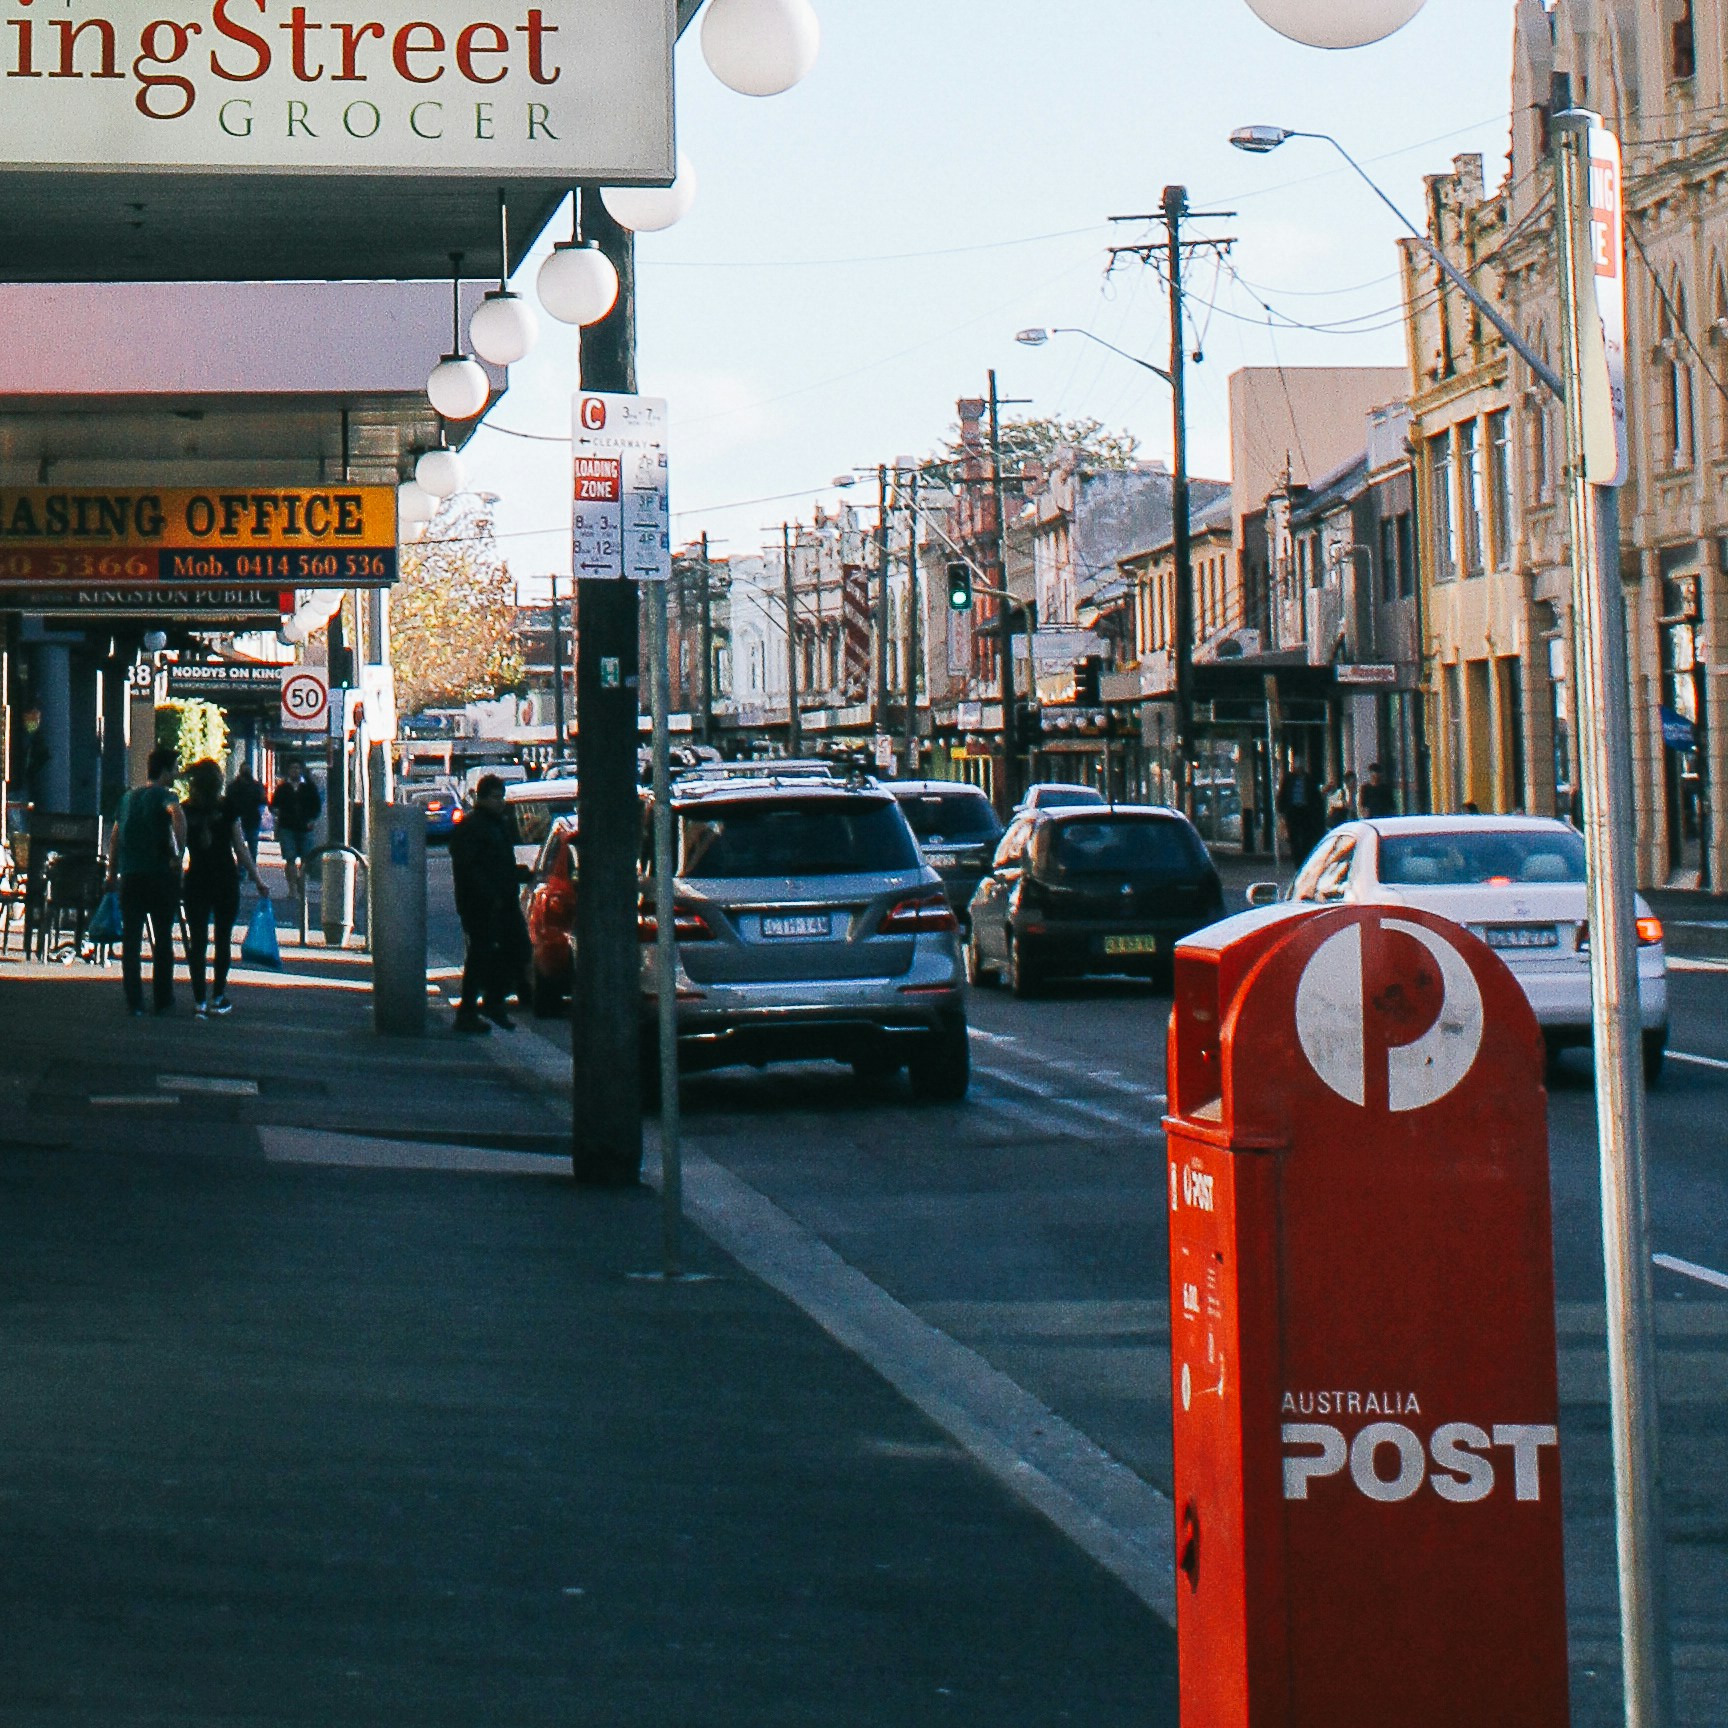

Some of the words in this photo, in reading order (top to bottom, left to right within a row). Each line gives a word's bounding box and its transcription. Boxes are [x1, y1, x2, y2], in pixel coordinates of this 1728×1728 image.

[217, 98, 562, 142] GROCER
[584, 398, 602, 430] C
[592, 437, 648, 448] CLEARWAY
[574, 458, 618, 478] LOADING
[580, 479, 613, 498] ZONE
[184, 492, 365, 539] OFFICE
[45, 550, 150, 579] 5366
[171, 554, 231, 579] Mob.
[236, 554, 289, 578] 0414
[295, 554, 338, 578] 560
[344, 554, 386, 578] 536
[78, 590, 190, 604] KINGSTON
[194, 590, 272, 605] PUBLIC
[171, 666, 227, 679] NODDYS
[228, 667, 250, 679] ON
[291, 688, 319, 708] 50
[1281, 1391, 1421, 1417] AUSTRALIA
[1280, 1422, 1559, 1504] POST
